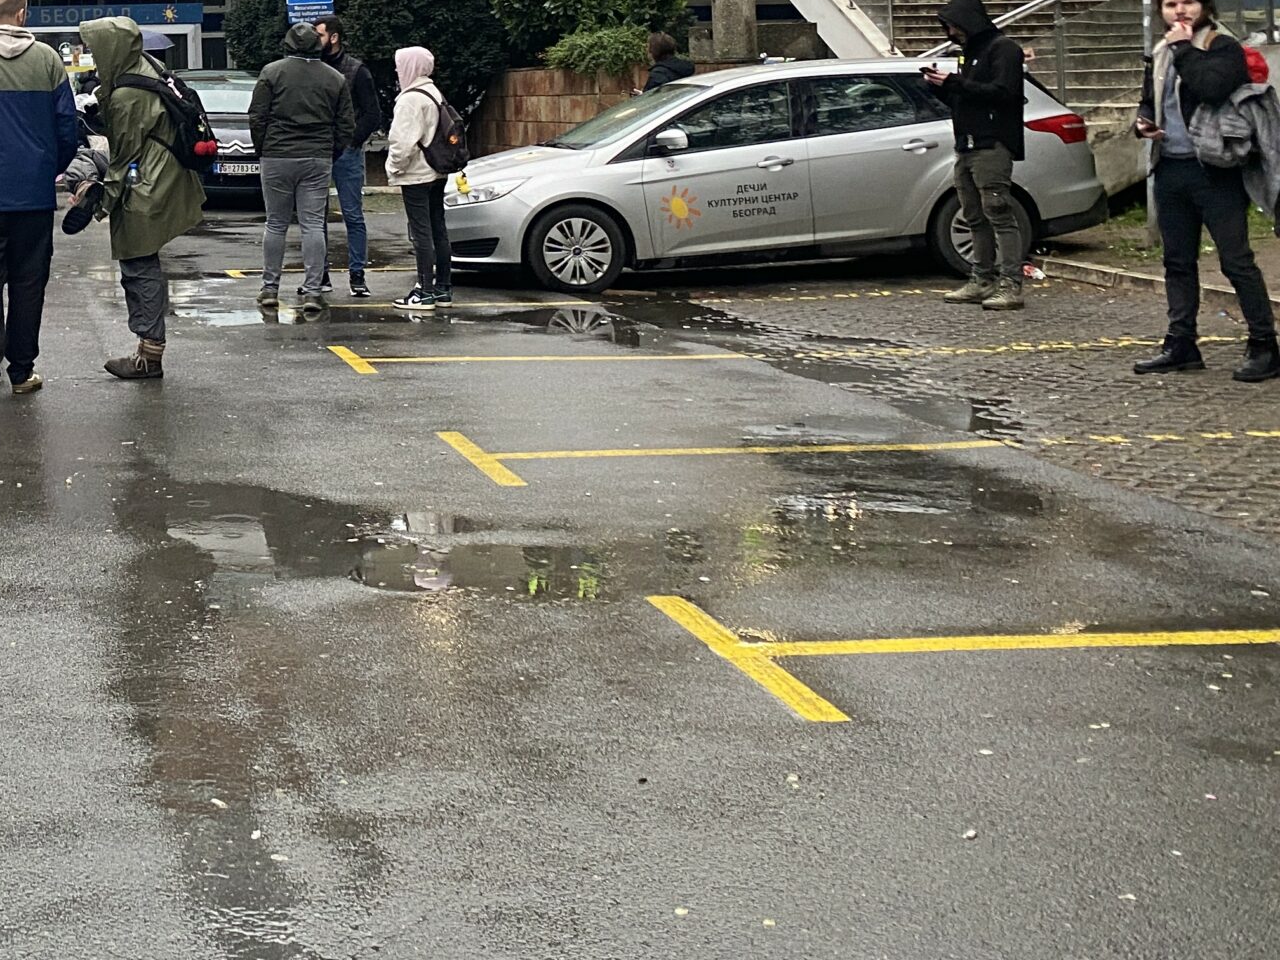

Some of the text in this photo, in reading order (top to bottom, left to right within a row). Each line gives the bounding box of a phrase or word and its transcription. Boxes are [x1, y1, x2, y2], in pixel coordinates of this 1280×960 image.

[736, 183, 768, 194] ДЕЧЈИ
[707, 192, 800, 208] КУЛТУРНИ ЦЕНТАР
[732, 206, 777, 218] БЕОГРАД
